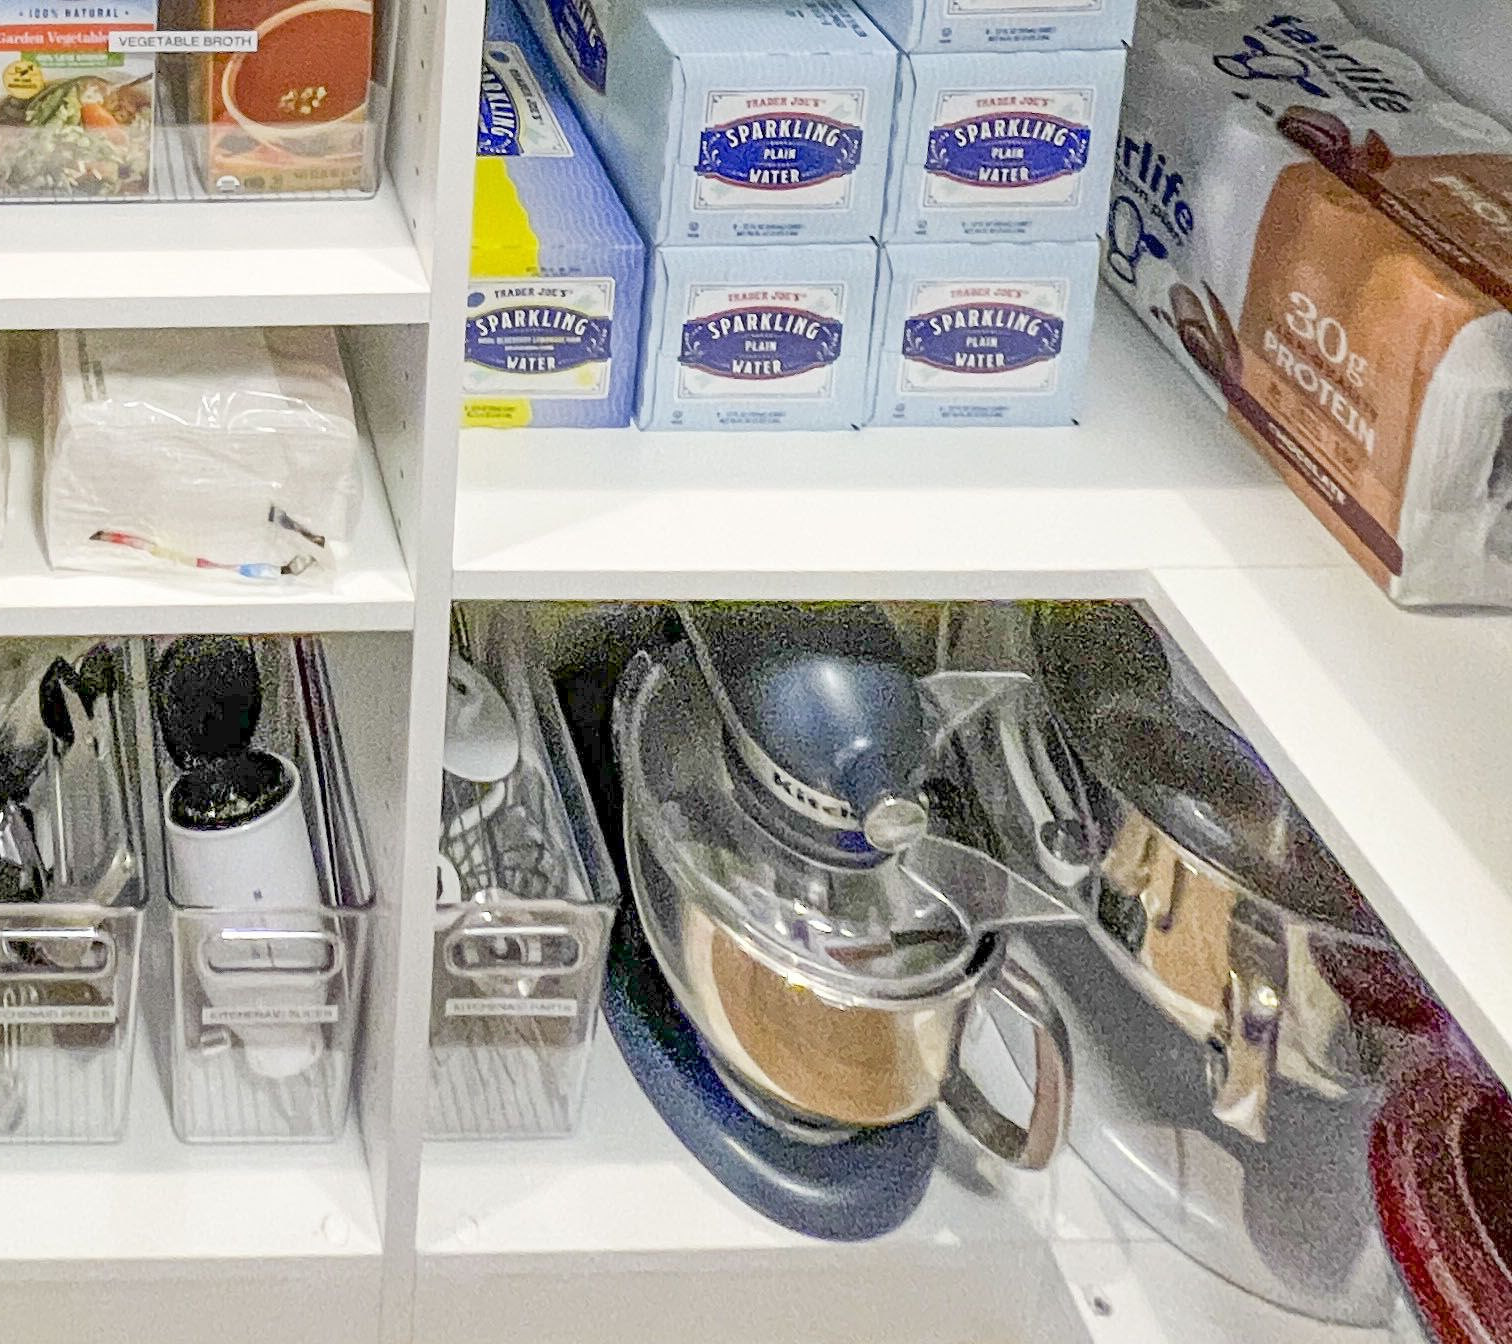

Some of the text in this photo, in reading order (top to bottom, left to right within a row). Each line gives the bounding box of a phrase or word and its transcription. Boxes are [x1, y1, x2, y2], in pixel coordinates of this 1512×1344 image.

[64, 8, 119, 19] NATURAL
[118, 36, 252, 48] VEGETABLE BROTH
[746, 96, 820, 108] TRADER JOE'S
[976, 95, 1050, 108] TRADER JOE'S
[725, 118, 841, 148] SPARKLING
[954, 118, 1069, 148] SPARKLING
[763, 147, 796, 160] PLAIN
[991, 146, 1025, 160] PLAIN
[748, 167, 801, 184] WATER
[977, 166, 1030, 184] WATER
[494, 288, 569, 299] TRADER JOE'S
[727, 291, 801, 302] TRADER JOE'S
[950, 288, 1024, 299] TRADER JOE'S
[475, 308, 589, 337] SPARKLING
[707, 311, 822, 341] SPARKLING
[929, 308, 1043, 337] SPARKLING
[744, 340, 778, 353] PLAIN
[965, 336, 998, 349] PLAIN
[1284, 291, 1369, 388] 30g
[506, 355, 556, 371] WATER
[732, 358, 783, 376] WATER
[954, 352, 1006, 369] WATER
[1264, 329, 1376, 454] PROTEIN
